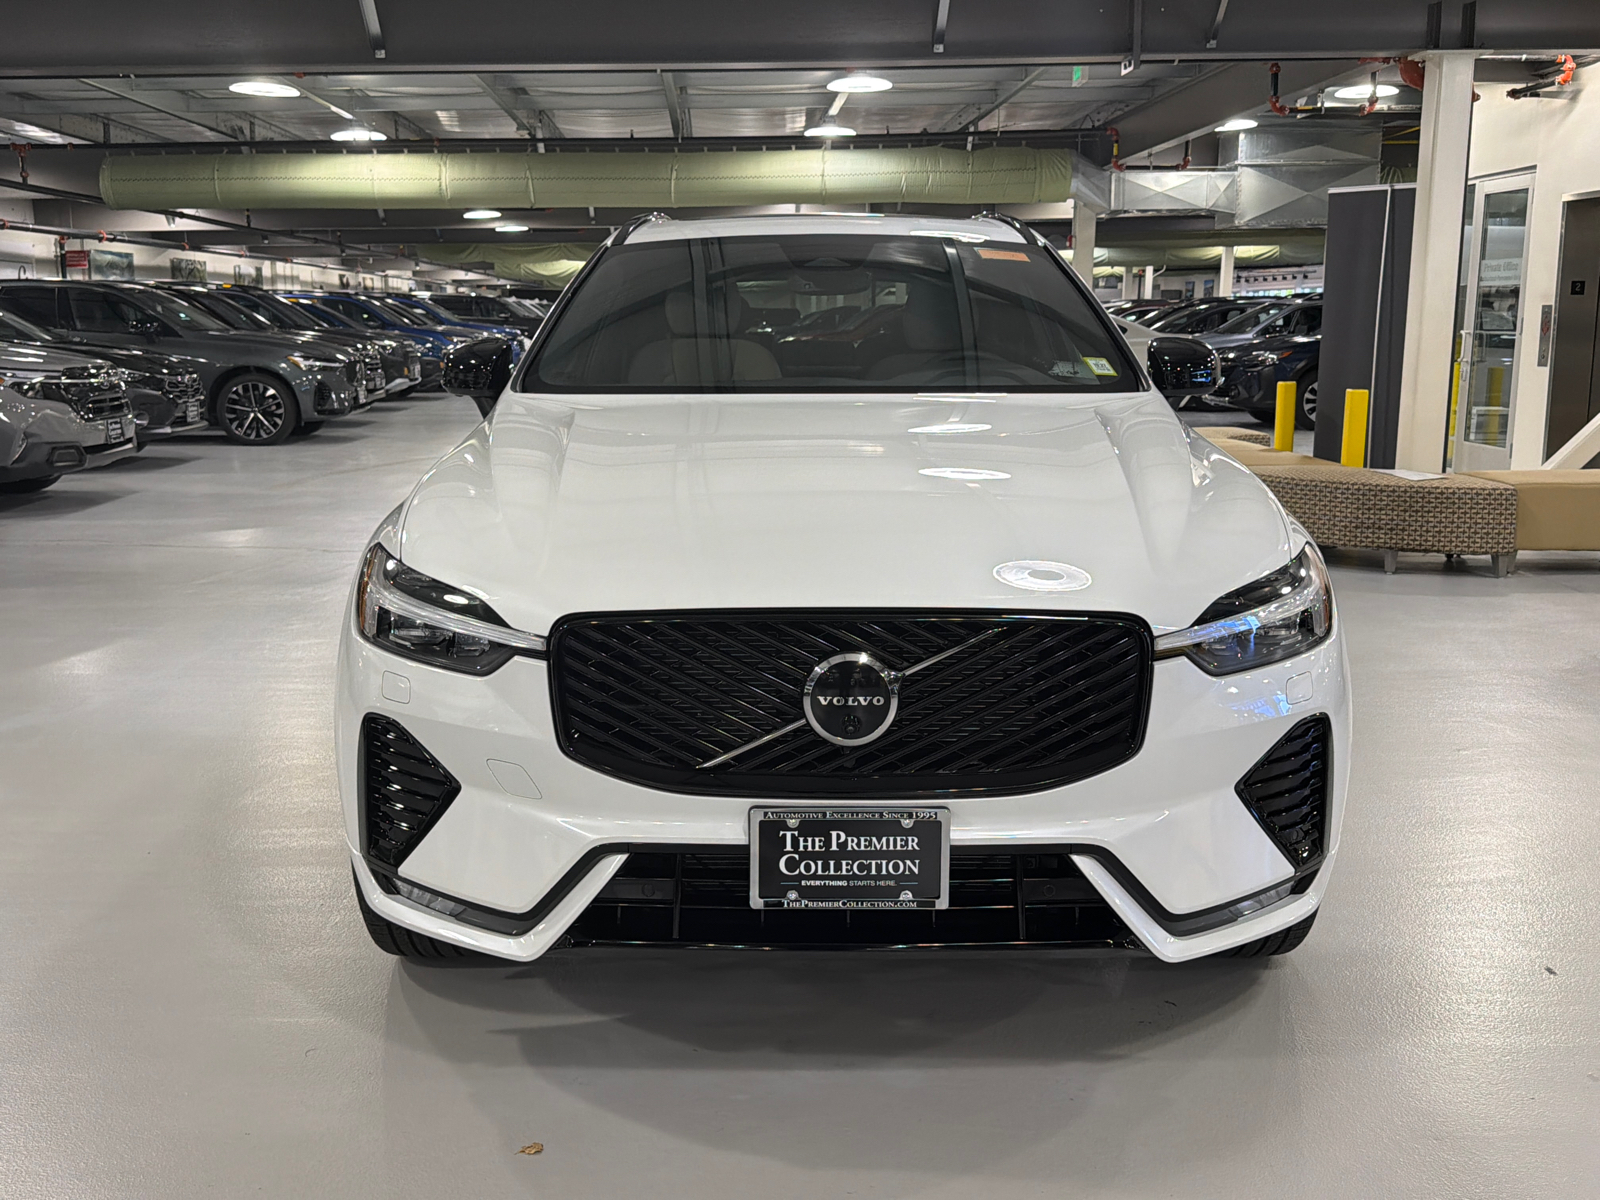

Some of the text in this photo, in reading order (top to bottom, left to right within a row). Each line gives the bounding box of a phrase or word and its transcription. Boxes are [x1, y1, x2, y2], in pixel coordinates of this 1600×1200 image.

[1575, 282, 1581, 291] 2
[817, 696, 885, 706] VOLVO
[765, 811, 937, 819] AUTOMOTIVE EXCELLENCE SINCE 1995
[779, 830, 920, 852] THE PREMIER
[778, 853, 920, 876] COLLECTION
